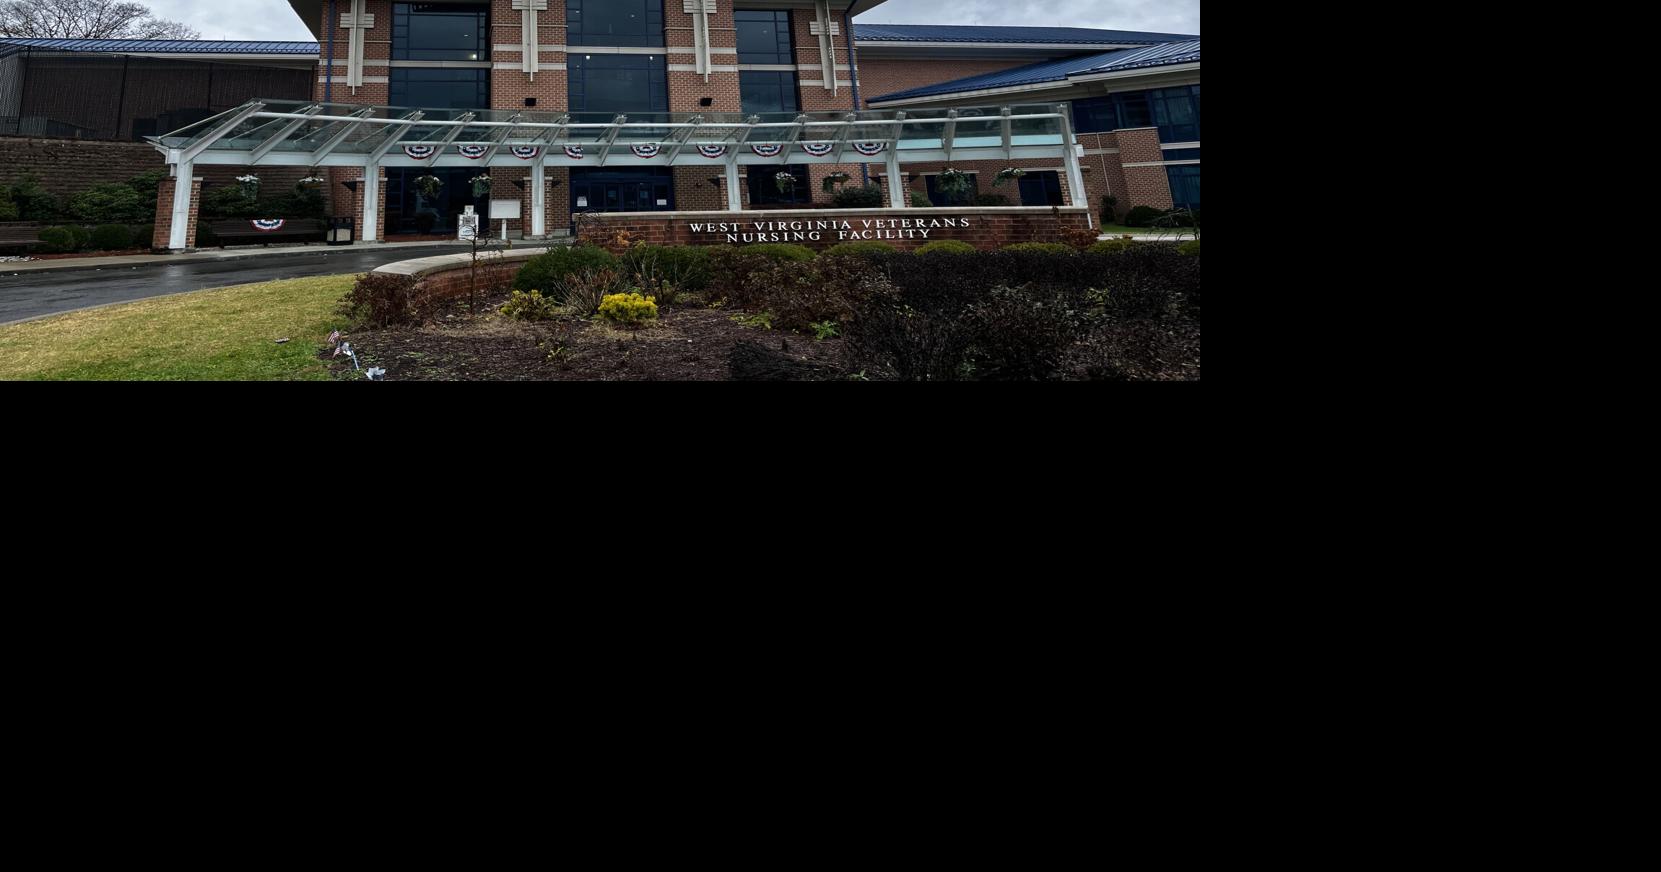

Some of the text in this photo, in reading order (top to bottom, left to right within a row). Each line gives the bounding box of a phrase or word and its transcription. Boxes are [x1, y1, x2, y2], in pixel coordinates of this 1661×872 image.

[690, 218, 970, 232] WEST VIRGINIA VETERANS
[727, 229, 930, 243] NURSING FACILITY
